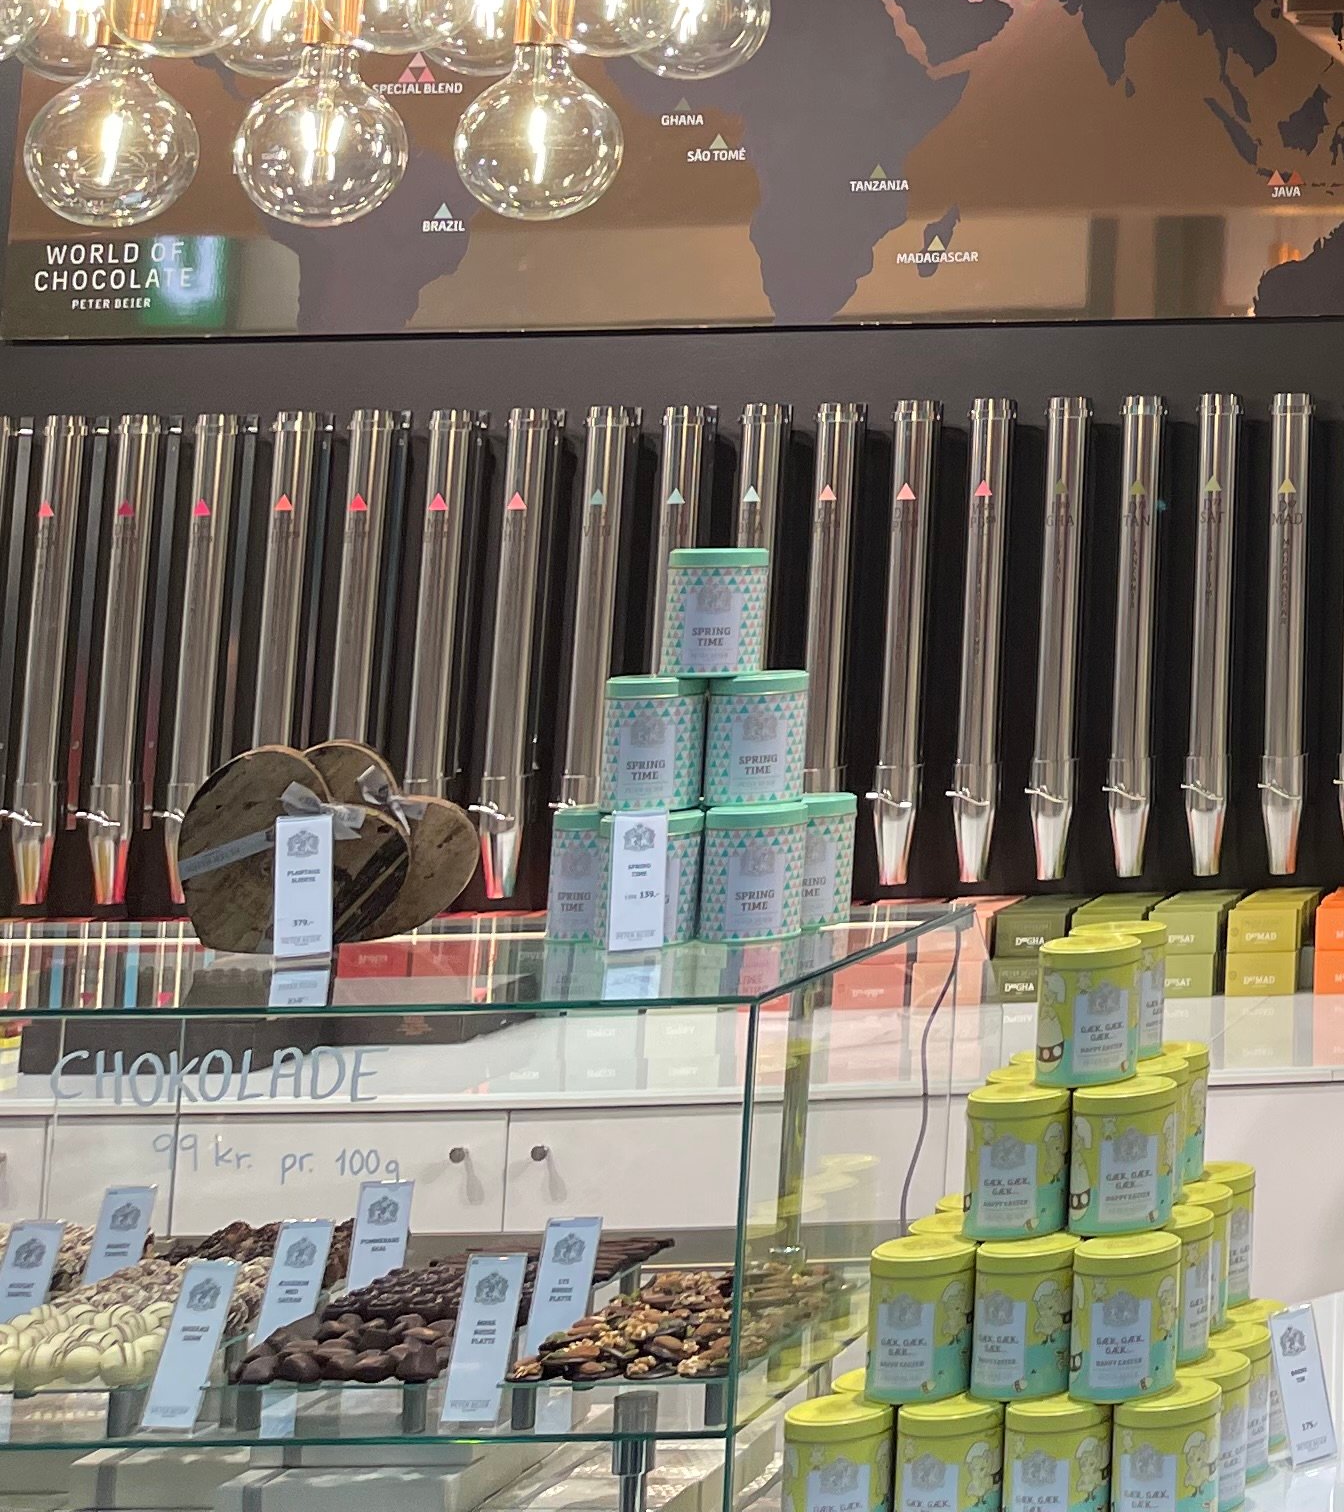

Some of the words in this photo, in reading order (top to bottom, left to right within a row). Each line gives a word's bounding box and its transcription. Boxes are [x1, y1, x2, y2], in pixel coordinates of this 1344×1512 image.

[372, 83, 422, 94] SPECIAL
[424, 82, 463, 94] BLEND
[661, 114, 704, 126] GHANA
[687, 149, 711, 162] SÃO
[713, 148, 746, 161] TOMÉ
[850, 180, 909, 191] TANZANIA
[1271, 186, 1301, 198] JAVA
[422, 220, 465, 232] BRAZIL
[47, 243, 139, 265] WORLD
[151, 242, 184, 263] OF
[896, 252, 978, 264] MADAGASCAR
[34, 267, 194, 292] CHOCOLATE
[71, 298, 110, 310] PETER
[691, 627, 731, 636] SPRING
[697, 638, 724, 647] TIME
[739, 754, 778, 765] SPRING
[744, 766, 771, 775] TIME
[735, 890, 775, 901] SPRING
[741, 901, 768, 912] TIME
[50, 1046, 392, 1107] CHOKOLADE
[153, 1133, 198, 1171] 99
[214, 1134, 252, 1170] kr.
[281, 1150, 313, 1184] pr.
